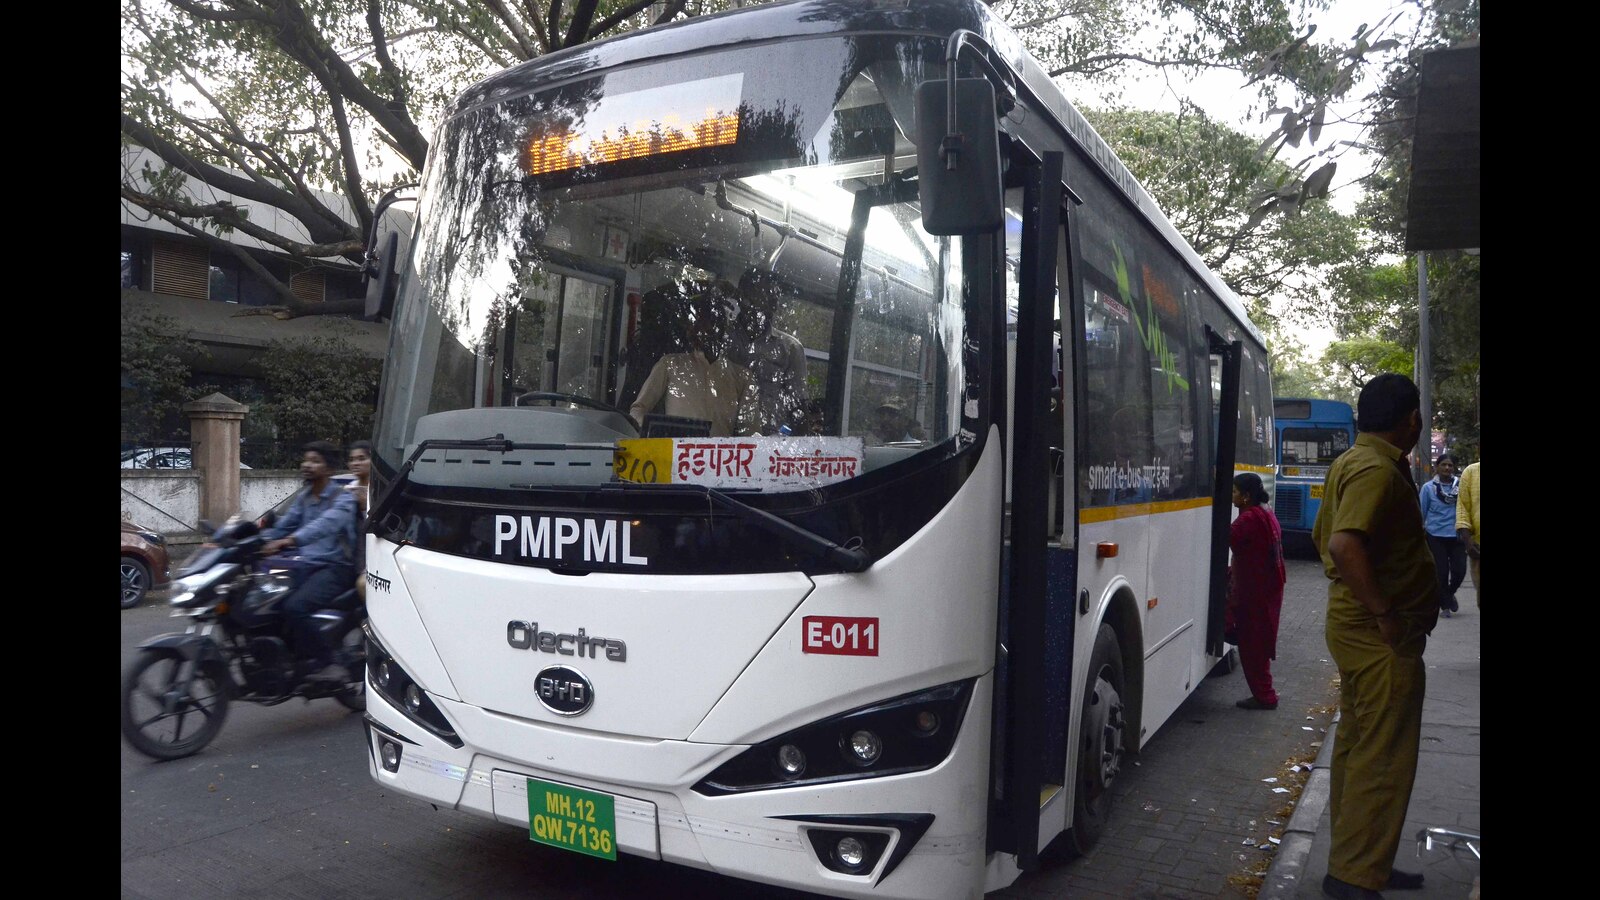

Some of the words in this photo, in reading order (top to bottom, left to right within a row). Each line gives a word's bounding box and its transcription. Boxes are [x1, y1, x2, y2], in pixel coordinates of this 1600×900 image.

[677, 443, 757, 481] हडपसर
[1089, 461, 1117, 490] smart
[1118, 460, 1141, 489] e-bus
[495, 514, 648, 566] PMPML
[507, 619, 627, 663] Olectra
[807, 621, 875, 650] E-011
[540, 677, 585, 704] BYD
[545, 791, 596, 824] MH.12
[533, 814, 612, 853] QW.7136
